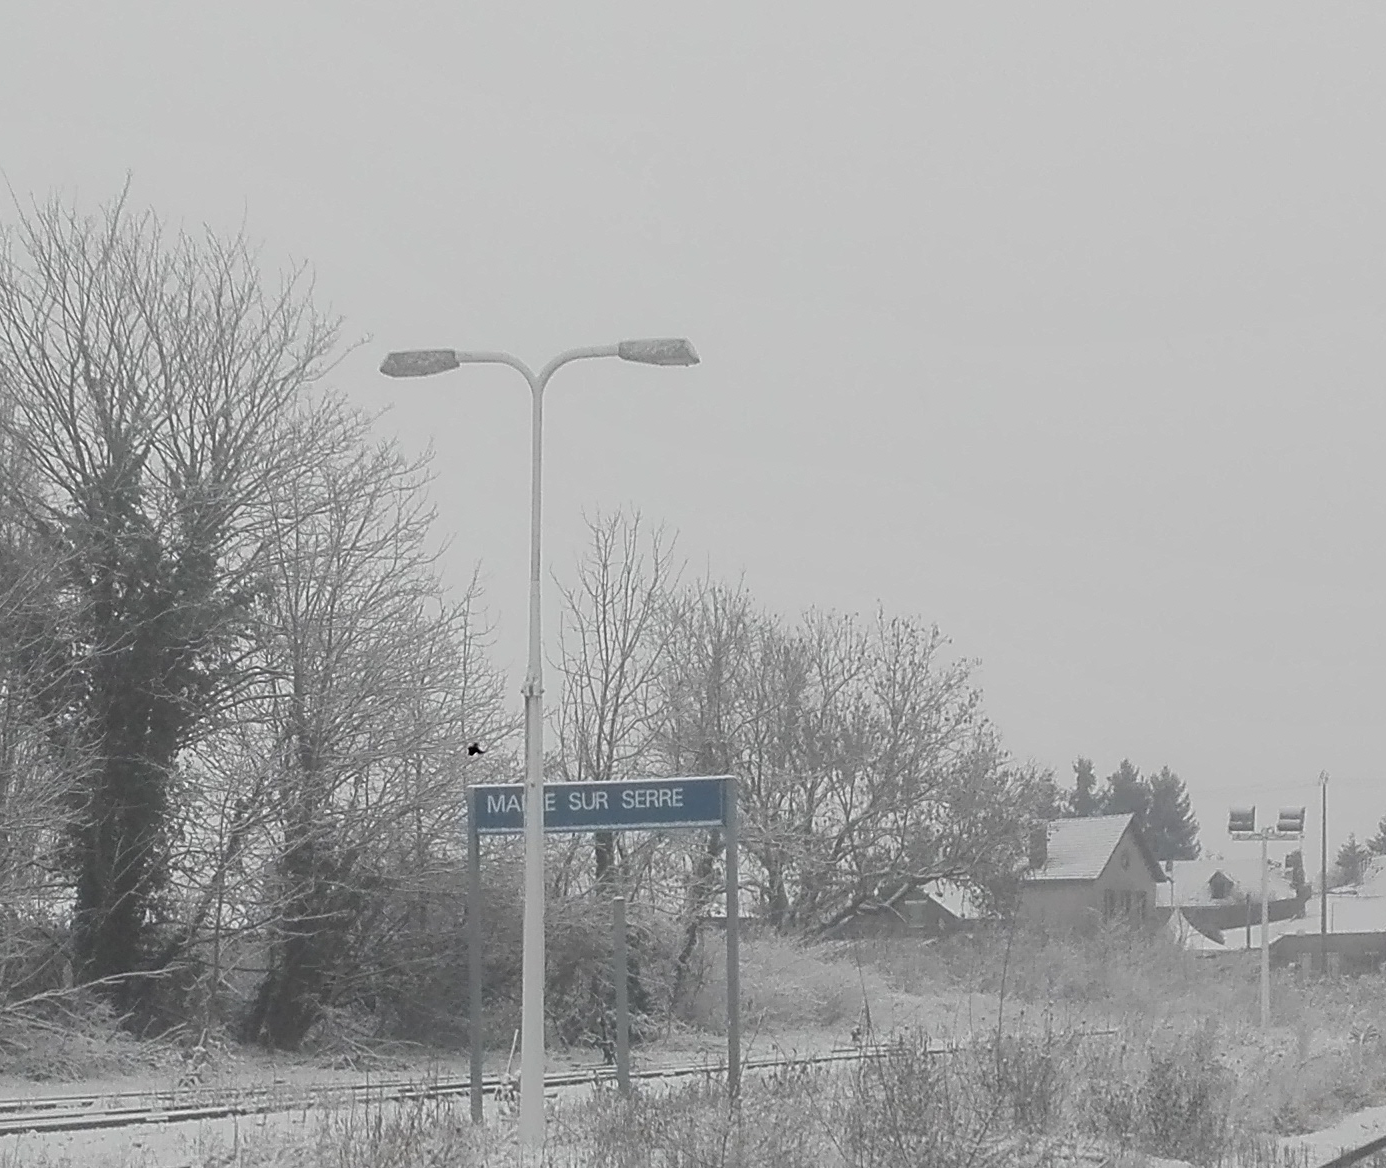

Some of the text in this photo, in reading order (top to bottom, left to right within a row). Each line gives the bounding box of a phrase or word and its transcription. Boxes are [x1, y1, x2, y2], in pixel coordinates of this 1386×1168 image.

[487, 788, 684, 813] MAE SUR SERRE
